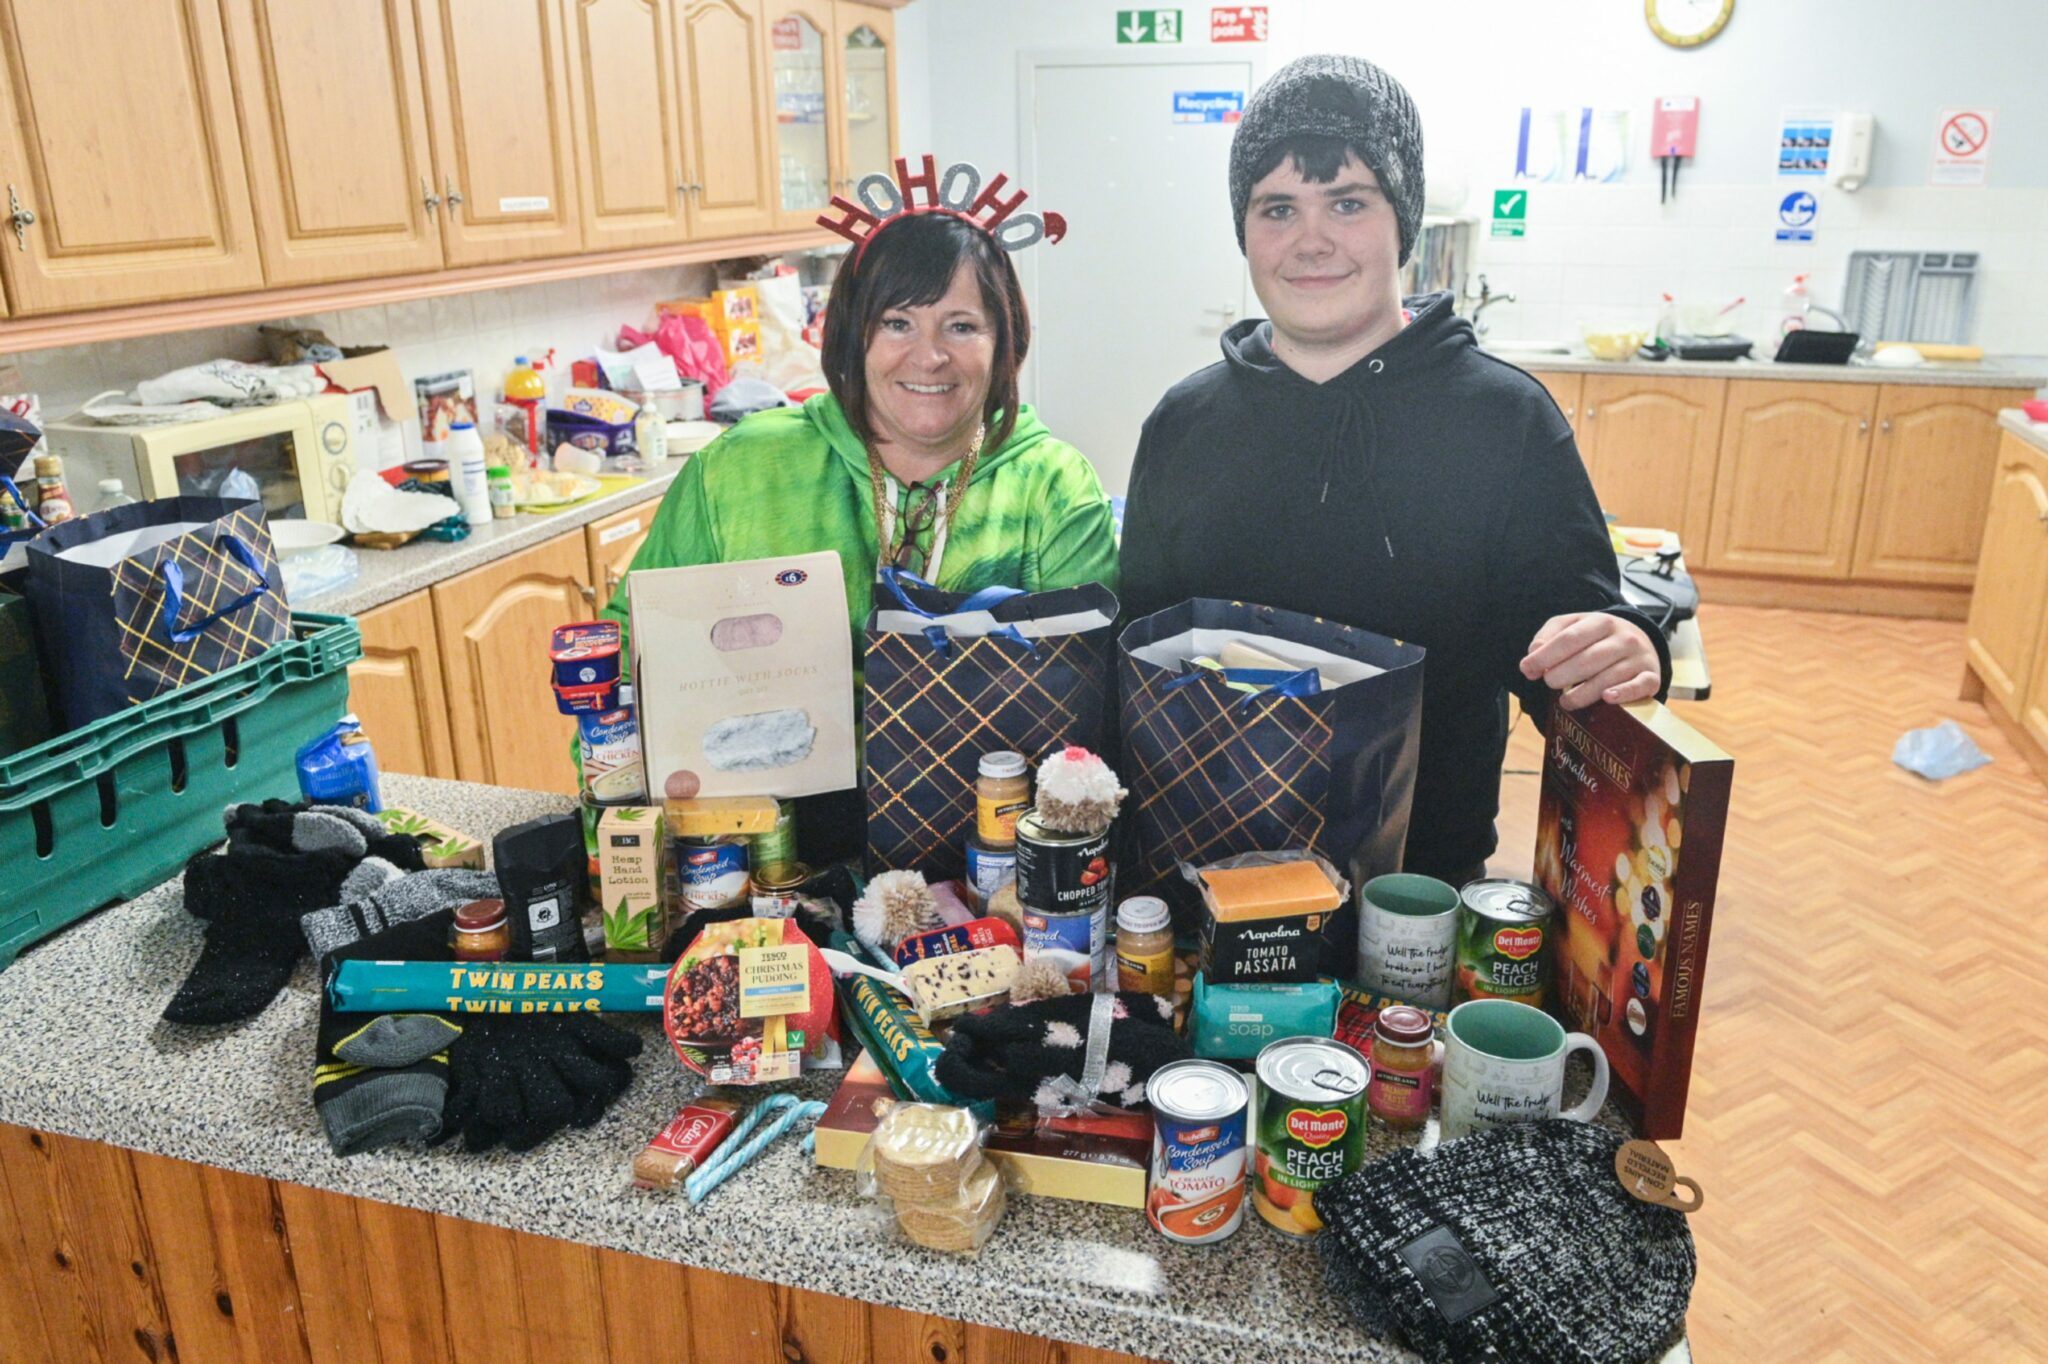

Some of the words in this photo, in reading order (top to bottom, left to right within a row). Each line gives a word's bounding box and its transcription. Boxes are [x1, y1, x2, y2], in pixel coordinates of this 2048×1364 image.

[1178, 97, 1239, 111] Recycling
[679, 676, 730, 692] HOTTIE
[735, 670, 772, 683] WITH
[776, 665, 819, 677] SOCKS
[1554, 707, 1590, 755] FAMOUS
[1592, 743, 1633, 790] NAMES
[1551, 734, 1599, 793] Signature
[611, 855, 643, 868] Hemp
[1559, 832, 1612, 904] Warmest
[613, 866, 642, 875] Hand
[608, 876, 649, 885] Lotion
[1057, 884, 1096, 901] CHOPPED
[1560, 868, 1598, 925] Wishes
[1238, 925, 1301, 942] Napolina
[1498, 936, 1514, 947] Del
[1516, 934, 1542, 946] Monte
[761, 952, 788, 962] TESCO
[1246, 945, 1289, 959] TOMATO
[1671, 955, 1693, 1020] FAMOUS
[1683, 900, 1701, 954] NAMES
[745, 962, 804, 975] CHRISTMAS
[1234, 956, 1297, 975] PASSATA
[1493, 961, 1540, 975] PEACH
[450, 968, 515, 990] TWIN
[522, 970, 604, 991] PEAKS
[752, 973, 798, 984] PUDDING
[1492, 973, 1538, 987] SLICES
[873, 1008, 915, 1062] PEAKS
[1229, 1023, 1275, 1038] soap
[1476, 1090, 1500, 1107] Well
[681, 1118, 709, 1145] Lotus
[1291, 1116, 1309, 1131] Del
[1311, 1119, 1345, 1132] Monte
[1167, 1131, 1233, 1160] Condensed
[1180, 1154, 1216, 1173] Soup
[1287, 1148, 1344, 1166] PEACH
[1629, 1148, 1670, 1174] MATERIAL
[1286, 1162, 1344, 1180] SLICES
[1626, 1158, 1667, 1182] RECYCLED
[1169, 1177, 1226, 1192] TOMATO
[1277, 1174, 1288, 1185] IN
[1290, 1179, 1320, 1189] LIGHT
